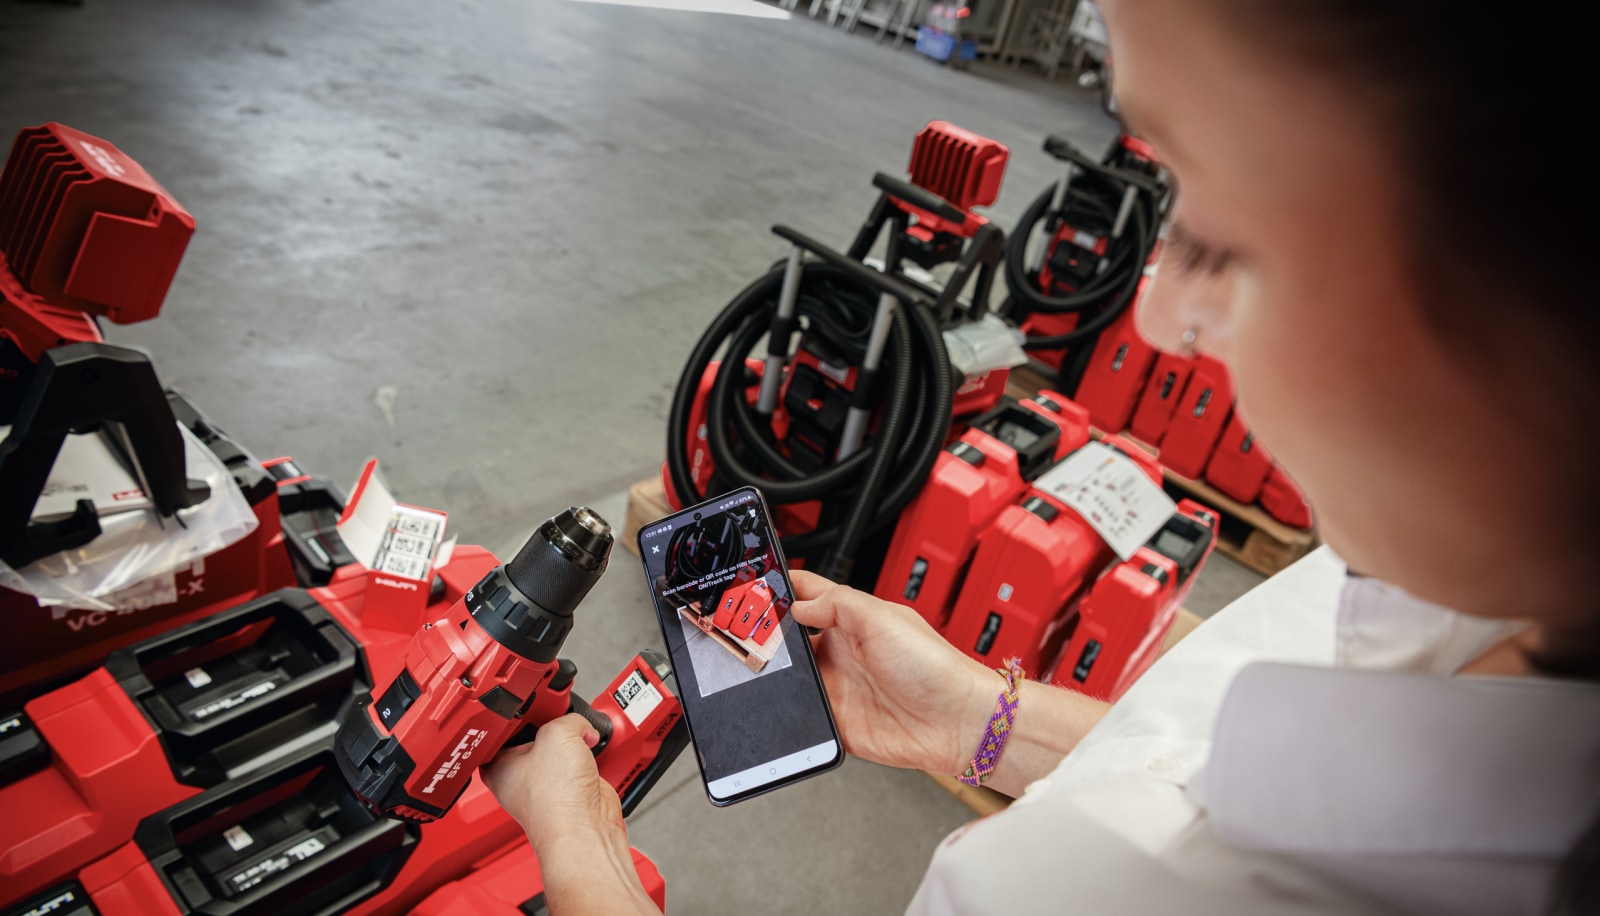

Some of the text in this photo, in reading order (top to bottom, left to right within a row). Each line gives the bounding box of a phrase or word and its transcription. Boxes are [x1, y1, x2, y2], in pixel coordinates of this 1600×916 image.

[662, 588, 676, 596] Scan
[676, 579, 698, 591] barcode
[715, 568, 728, 577] code
[724, 573, 736, 582] tags
[66, 611, 108, 632] VC
[382, 707, 391, 719] 2
[422, 728, 479, 794] HILTI
[446, 730, 489, 779] SF 6-22
[20, 891, 75, 916] LTI
